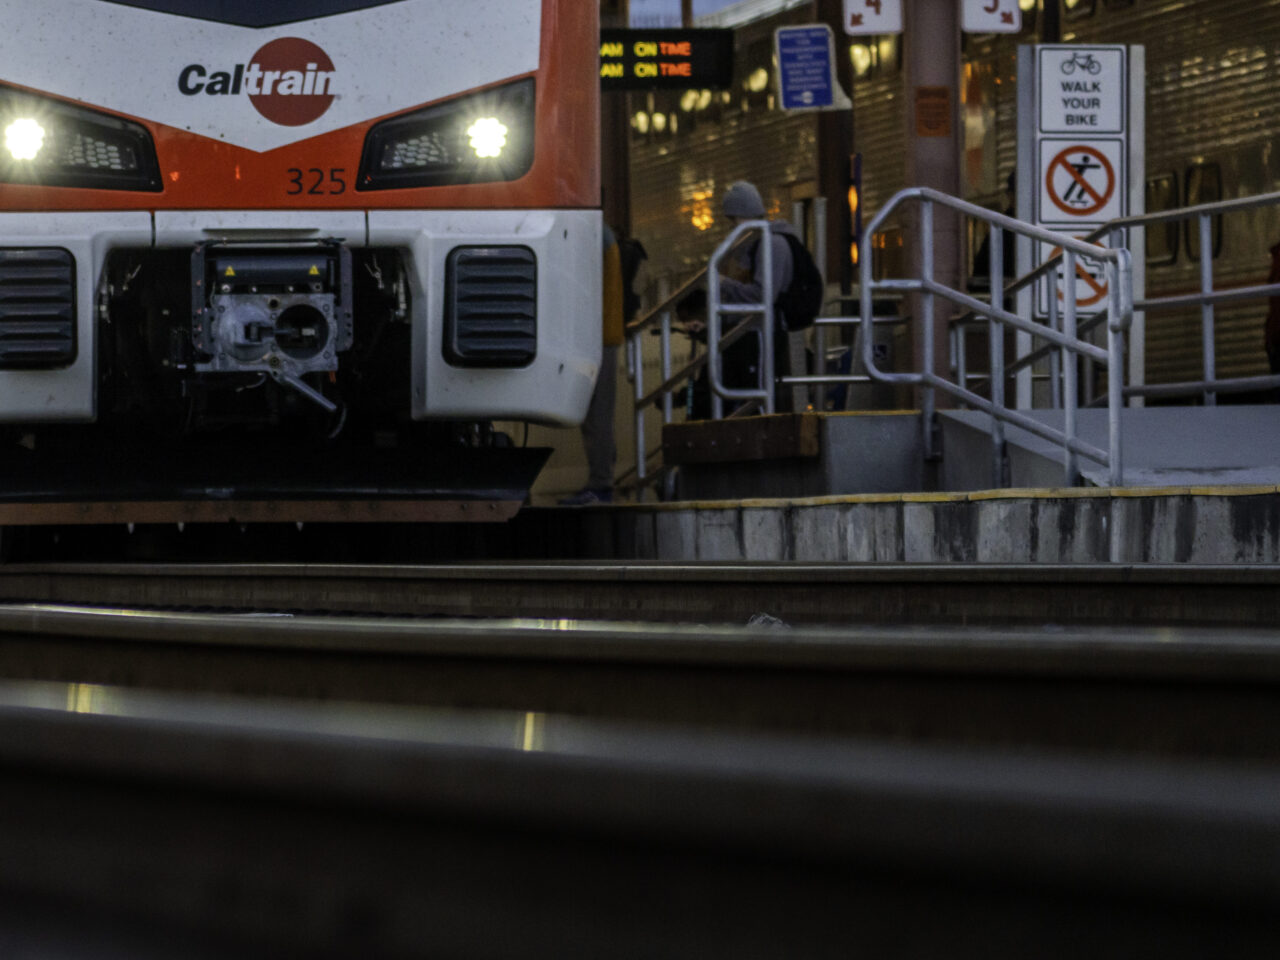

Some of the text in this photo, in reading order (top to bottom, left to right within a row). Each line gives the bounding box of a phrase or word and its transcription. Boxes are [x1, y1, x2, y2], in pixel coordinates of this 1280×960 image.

[600, 41, 691, 57] AM ON TIME
[600, 61, 692, 78] AM ON TIME
[178, 62, 339, 97] Caltrain
[1061, 81, 1100, 92] WALK
[1061, 97, 1100, 109] YOUR
[1065, 114, 1097, 126] BIKE
[287, 168, 346, 195] 325
